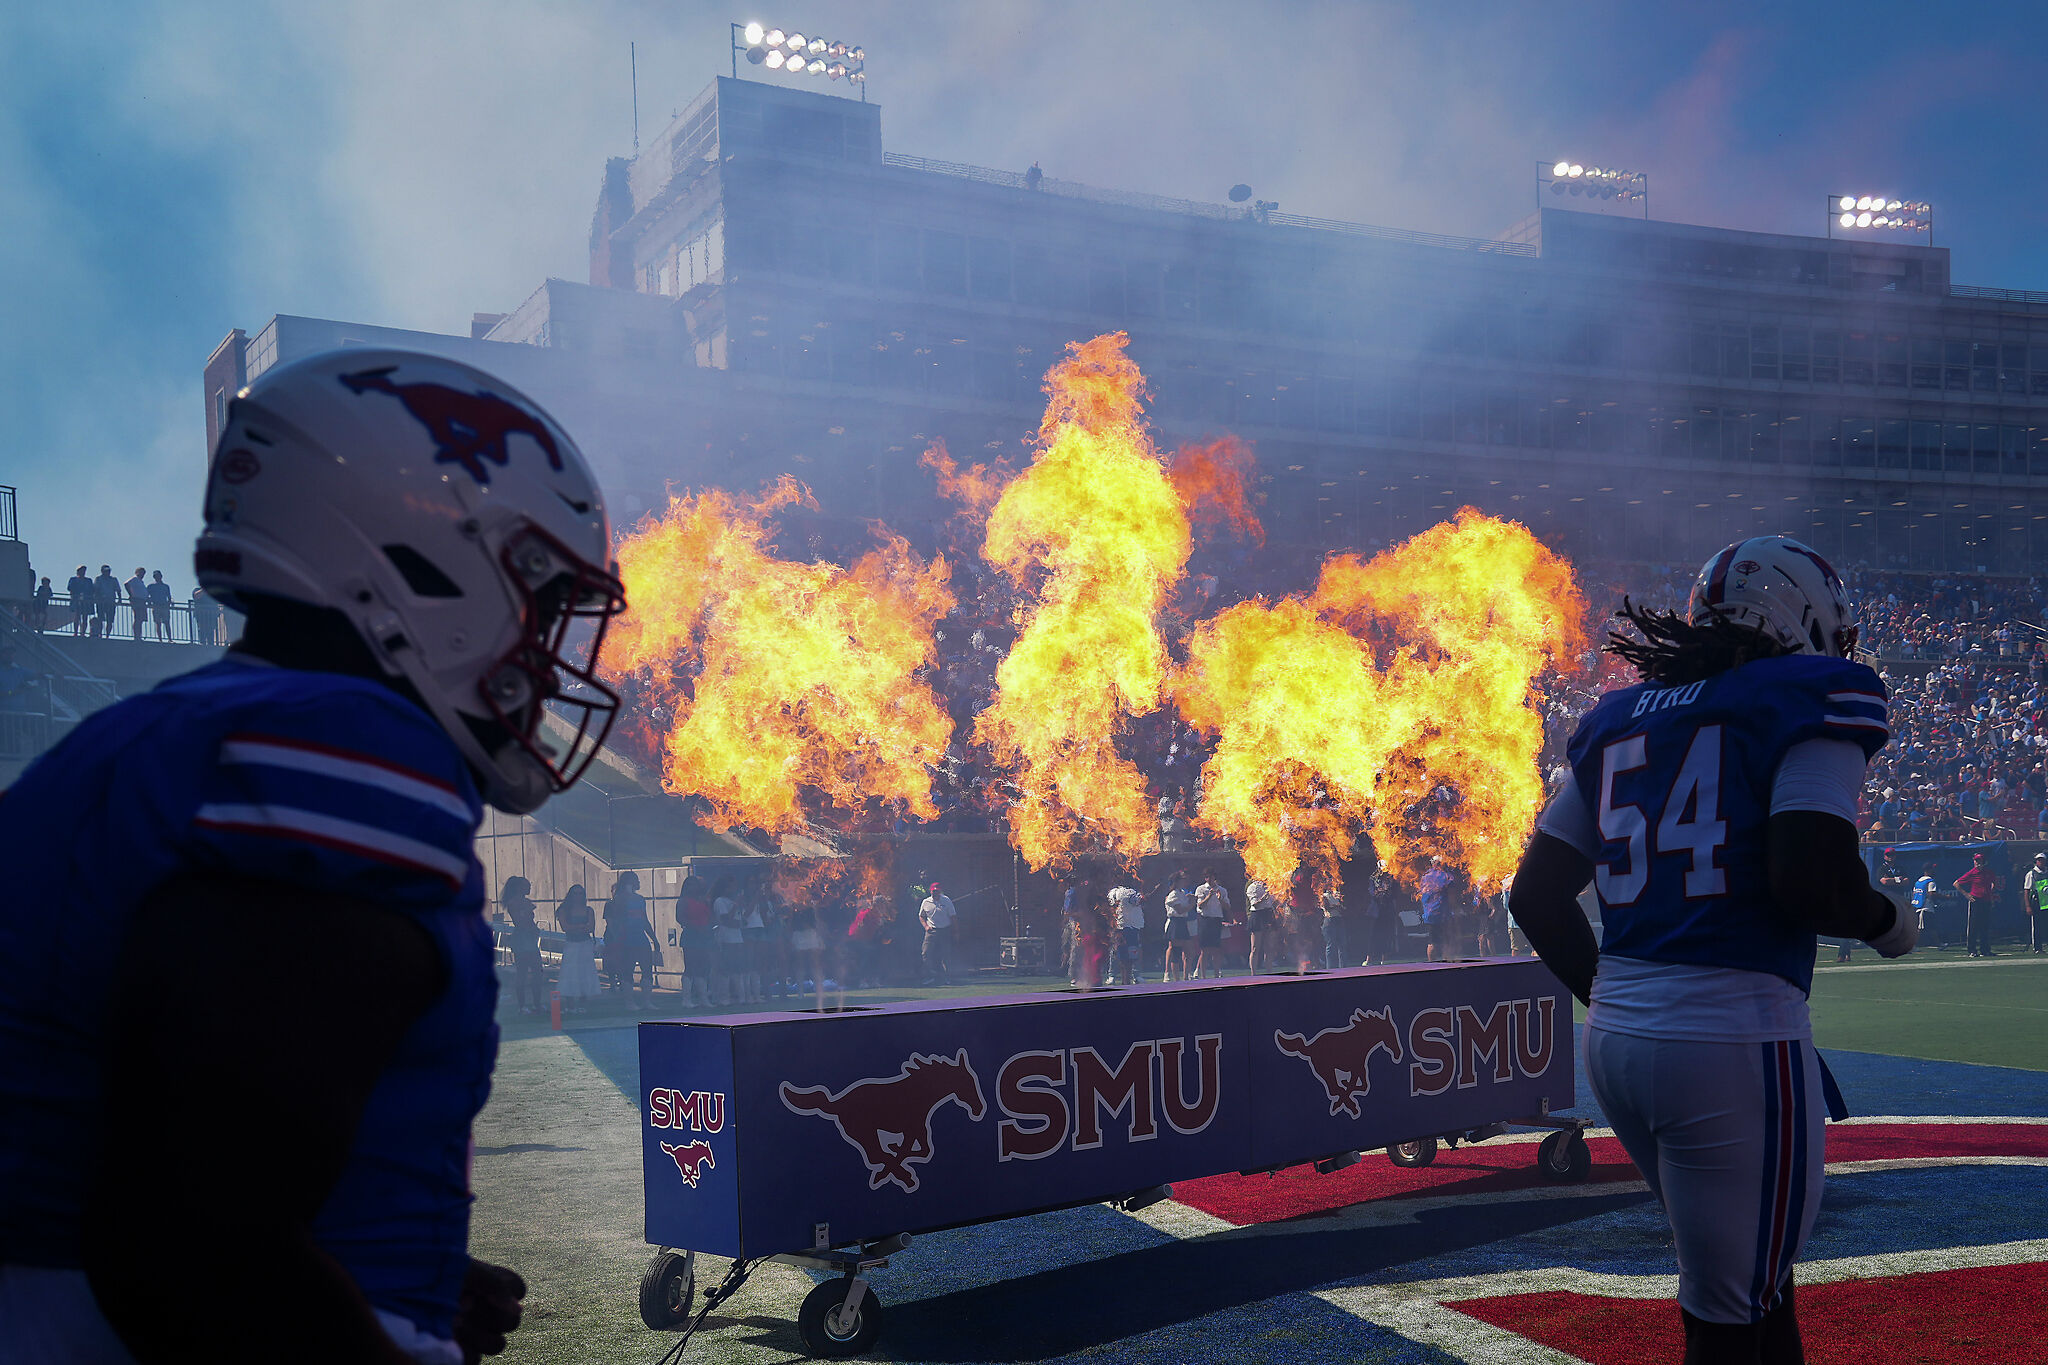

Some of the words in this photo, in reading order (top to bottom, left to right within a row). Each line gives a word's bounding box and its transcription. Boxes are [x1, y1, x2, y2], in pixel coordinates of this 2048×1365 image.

[1631, 679, 1707, 719] BYRD
[1596, 723, 1731, 909] 54
[1409, 996, 1555, 1097] SMU
[649, 1087, 725, 1134] SMU
[996, 1033, 1222, 1162] SMU
